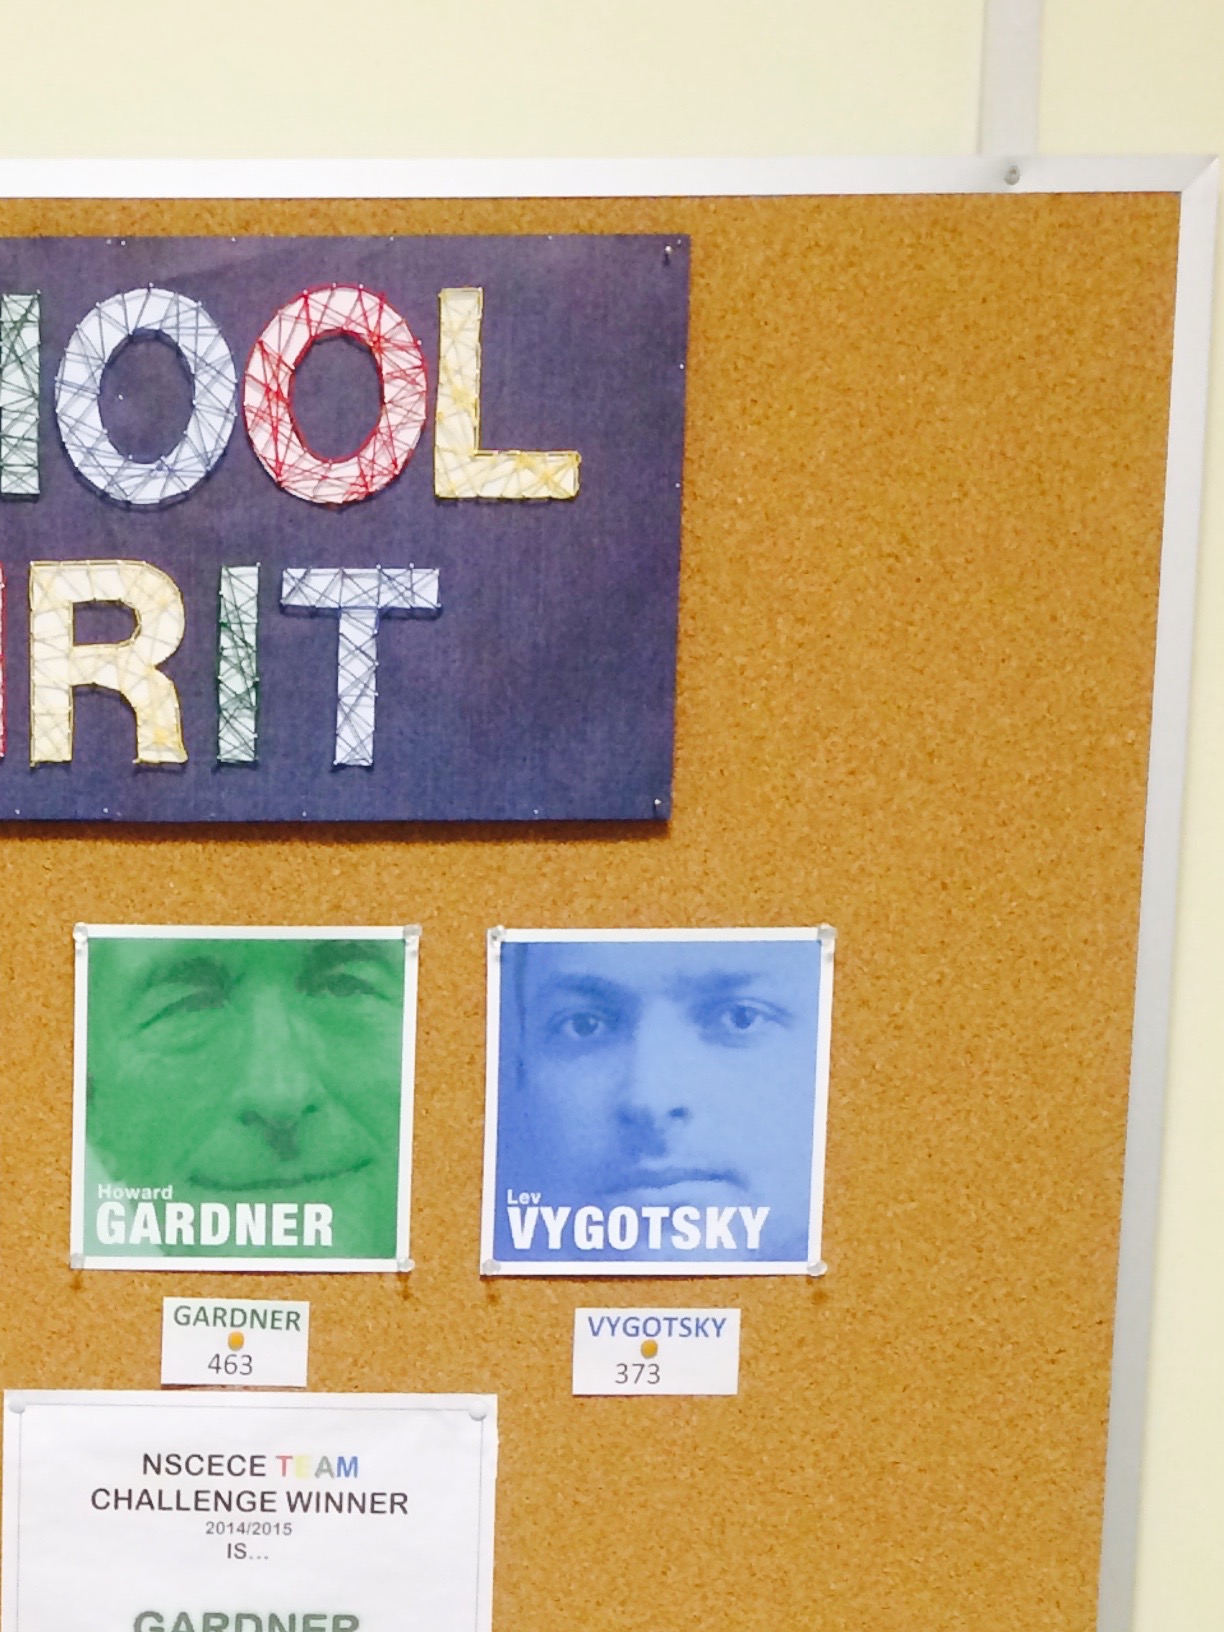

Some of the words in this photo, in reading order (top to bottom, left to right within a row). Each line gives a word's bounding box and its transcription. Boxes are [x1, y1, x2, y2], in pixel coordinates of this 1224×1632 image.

[96, 1183, 174, 1200] Howard
[506, 1190, 542, 1205] Lev
[95, 1202, 334, 1248] GARDNER
[506, 1205, 771, 1251] VYGOTSKY
[173, 1304, 302, 1332] GARDNER
[586, 1315, 728, 1340] VYGOTSKY
[206, 1352, 254, 1377] 463
[613, 1361, 661, 1386] 373
[142, 1453, 267, 1478] NSCECE
[276, 1454, 359, 1480] TEAM
[90, 1487, 277, 1513] CHALLENGE
[286, 1490, 409, 1515] WINNER
[204, 1520, 293, 1537] 2014/2015
[226, 1542, 269, 1561] IS...
